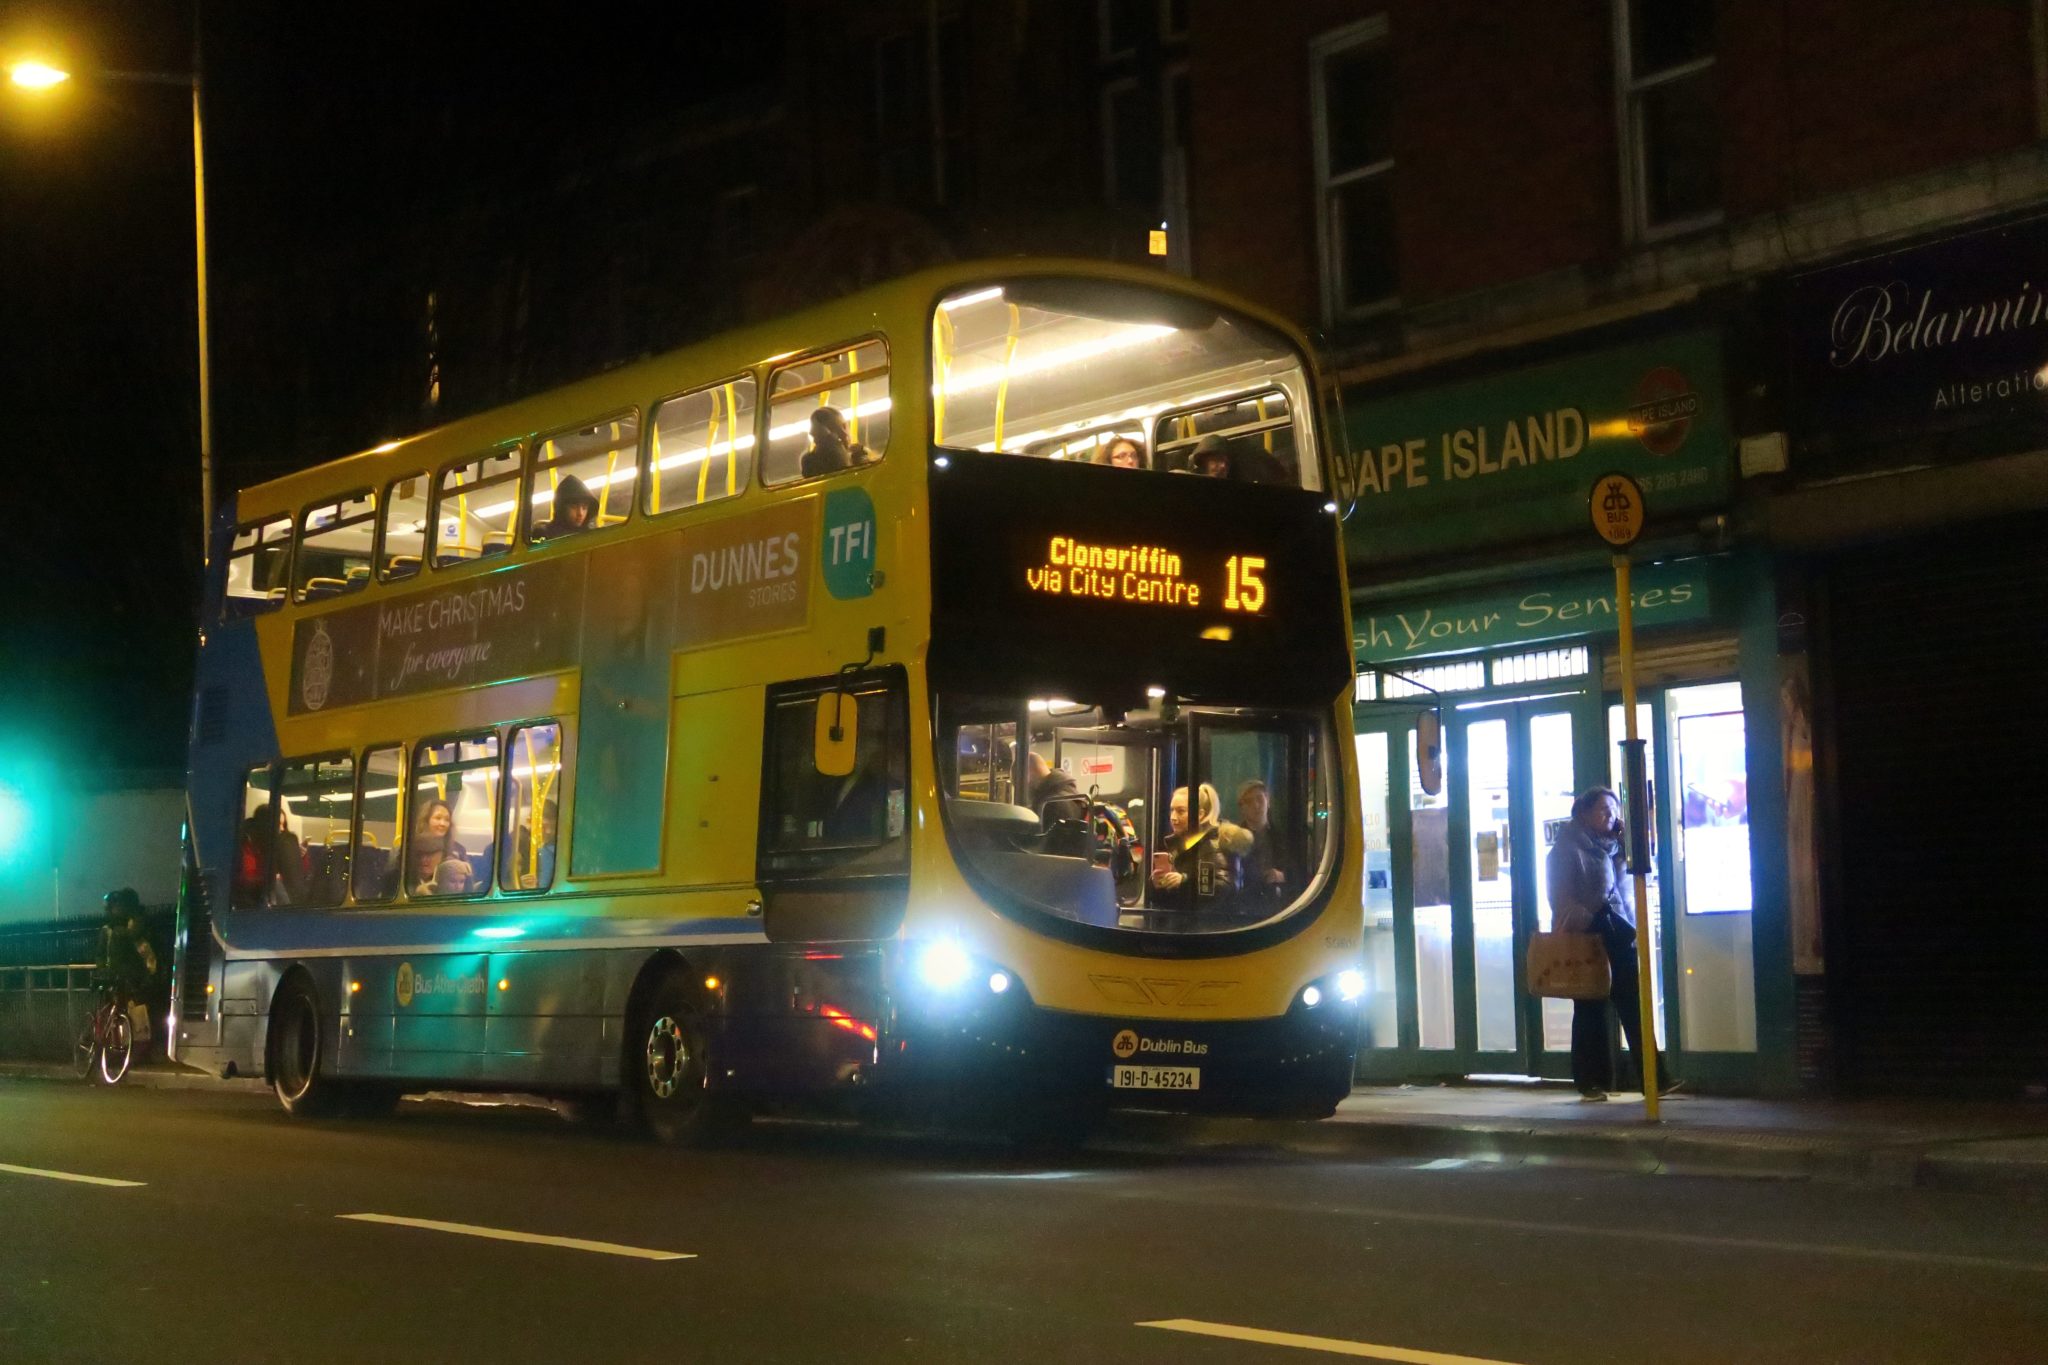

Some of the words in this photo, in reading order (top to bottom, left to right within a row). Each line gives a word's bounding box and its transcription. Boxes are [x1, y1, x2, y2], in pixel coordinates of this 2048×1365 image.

[1829, 280, 2048, 368] Belarmin
[1441, 407, 1584, 481] ISLAND
[1607, 512, 1629, 523] BUS
[691, 532, 799, 594] DUNNES
[829, 520, 870, 565] TFI
[1050, 537, 1181, 576] Clongriffin
[750, 580, 798, 609] STORES
[1027, 565, 1062, 593] via
[1070, 566, 1116, 598] City
[1123, 572, 1200, 606] Centre
[1225, 556, 1265, 612] 15
[378, 603, 425, 638] MAKE
[428, 581, 526, 630] CHRISTMAS
[1396, 609, 1500, 651] Your
[391, 641, 425, 691] for
[425, 640, 492, 680] everyone
[414, 974, 433, 994] Bus
[1140, 1037, 1182, 1054] Dublin
[1183, 1040, 1209, 1055] Bus
[1120, 1070, 1193, 1088] 191-D-45234
